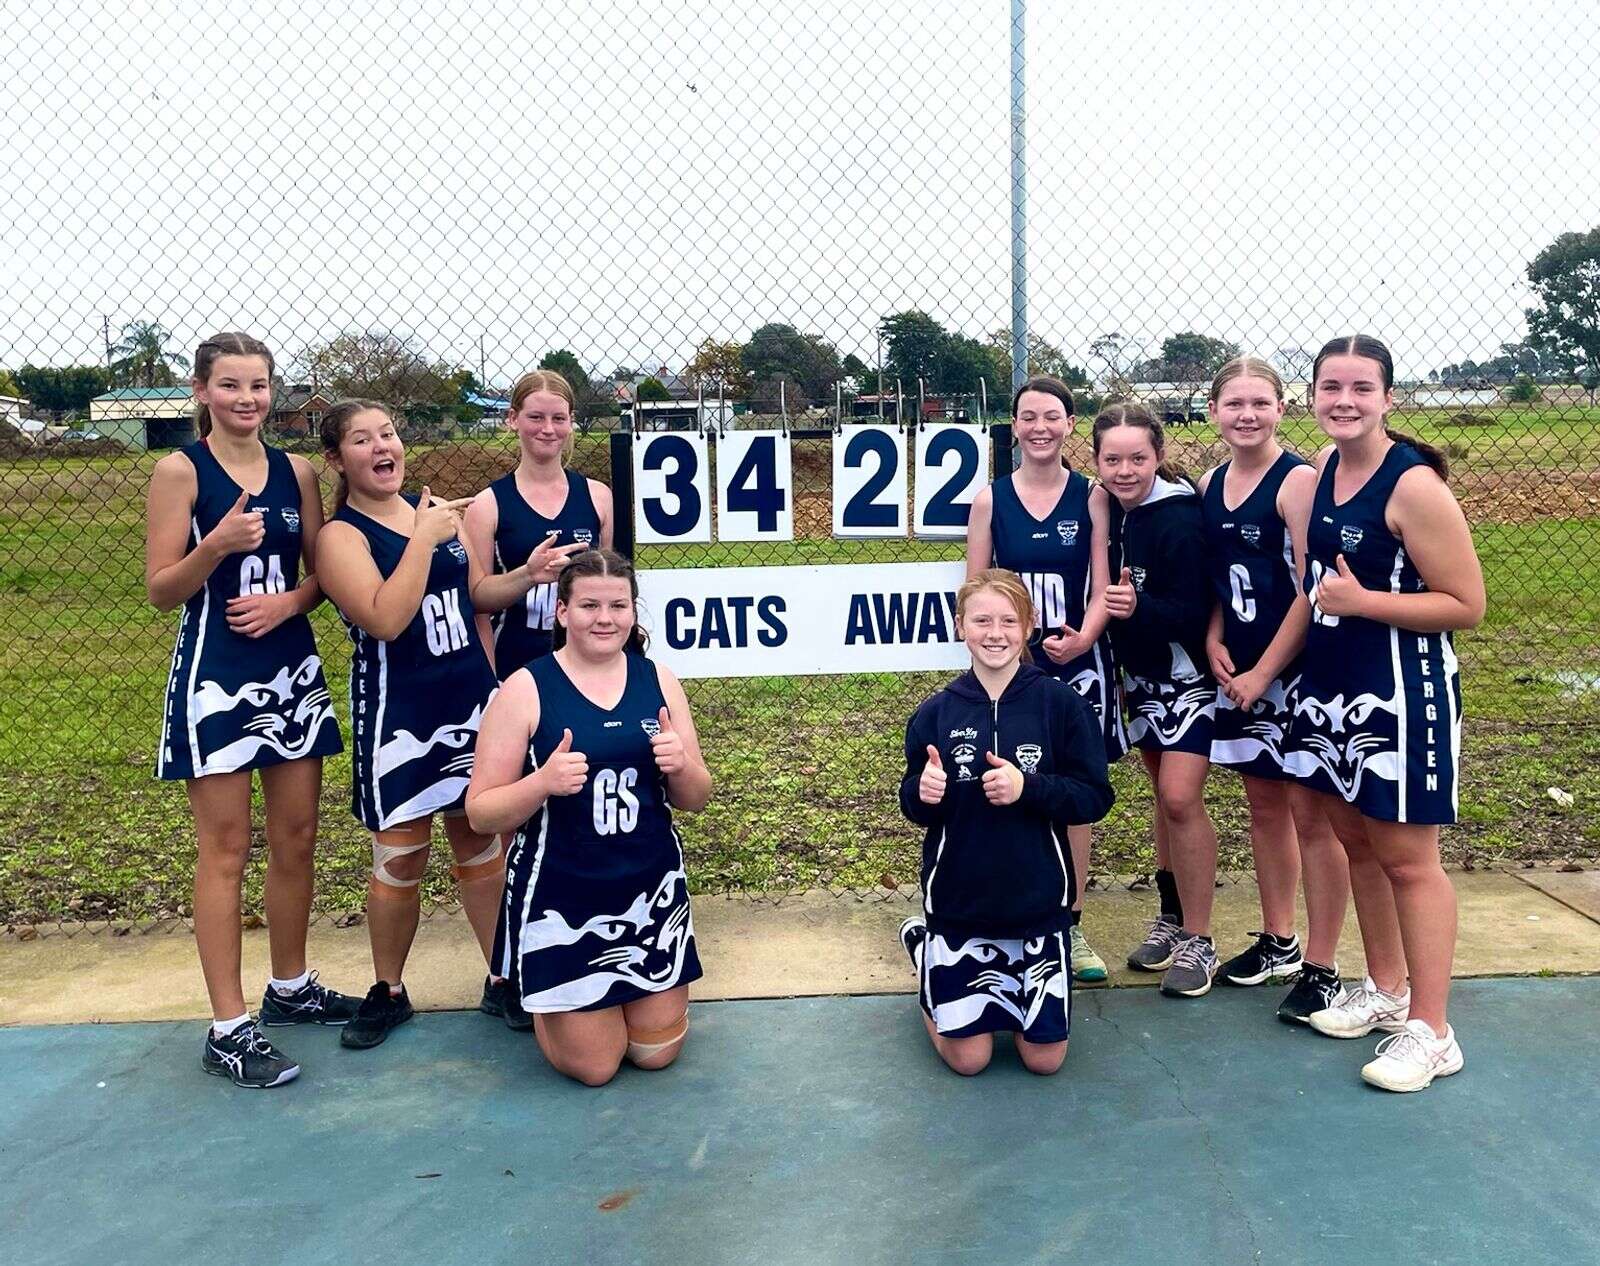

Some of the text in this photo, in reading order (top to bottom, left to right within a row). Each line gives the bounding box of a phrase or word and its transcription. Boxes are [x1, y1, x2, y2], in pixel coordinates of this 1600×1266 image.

[642, 428, 980, 537] 34 22
[422, 587, 469, 656] GK
[526, 583, 559, 630] W
[665, 595, 788, 650] CATS
[1229, 564, 1257, 622] C
[1417, 636, 1438, 792] HERGLEN
[592, 767, 640, 836] GS
